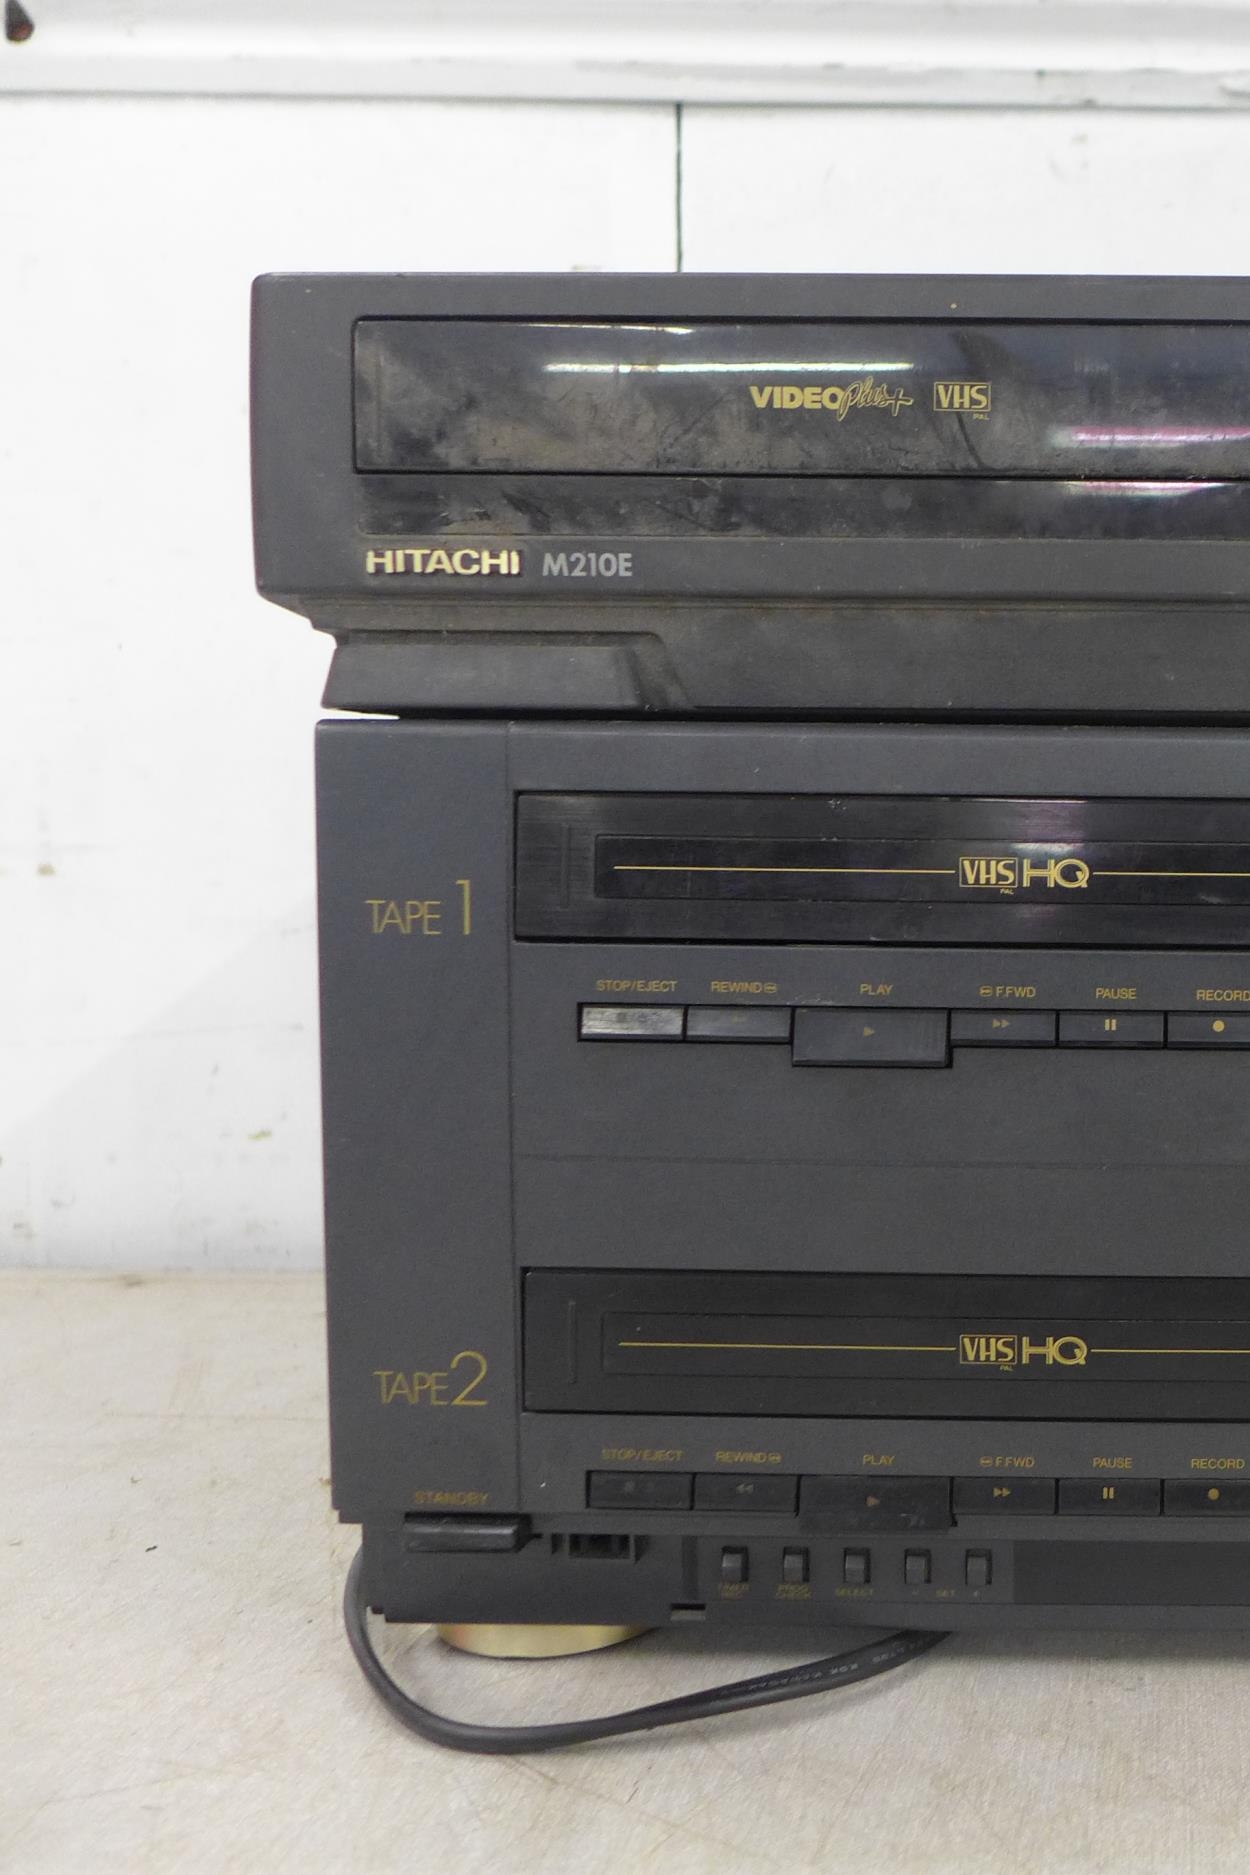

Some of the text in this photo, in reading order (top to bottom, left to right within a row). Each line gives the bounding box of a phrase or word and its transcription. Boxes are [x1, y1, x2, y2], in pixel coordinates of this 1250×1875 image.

[749, 385, 840, 410] VIDEO
[935, 383, 989, 409] VHS
[365, 548, 522, 576] HITACHI
[542, 552, 633, 577] M210E
[962, 858, 1090, 888] VHS HQ
[366, 879, 472, 936] TAPE 1
[596, 979, 678, 993] STOP/EJECT
[711, 981, 763, 994] REWIND
[860, 983, 894, 996] PLAY
[1095, 987, 1137, 1000] PAUSE
[962, 1335, 1088, 1365] VHS HQ
[373, 1350, 488, 1407] TAPE 2
[601, 1447, 684, 1462] STOP/EJECT
[714, 1450, 768, 1464] REWIND
[862, 1454, 896, 1466] PLAY
[1092, 1456, 1133, 1469] PAUSE
[1190, 1457, 1246, 1470] RECORD
[414, 1491, 489, 1505] STANDBY
[836, 1588, 875, 1597] SELECT
[936, 1589, 956, 1598] SET
